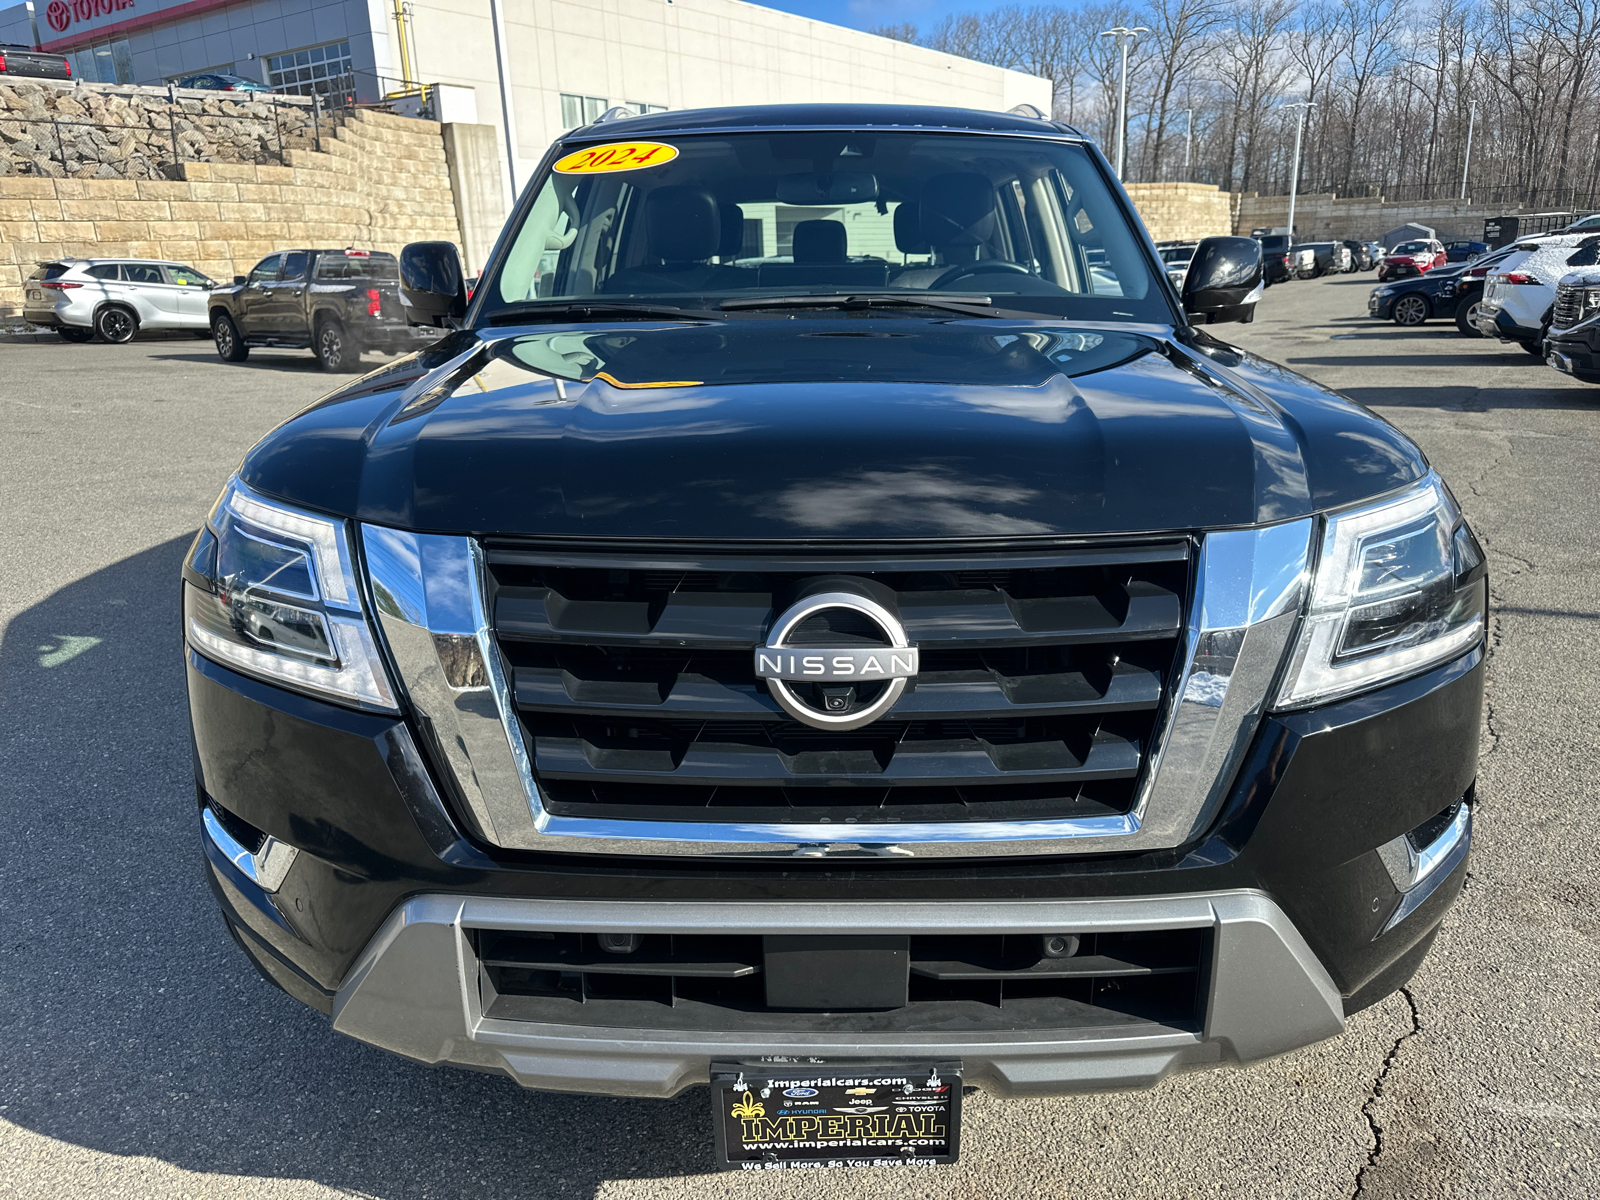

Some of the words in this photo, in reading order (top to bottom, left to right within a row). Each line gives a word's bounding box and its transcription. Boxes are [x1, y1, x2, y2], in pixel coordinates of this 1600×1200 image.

[567, 146, 662, 171] 2024
[759, 653, 913, 675] NISSAN
[848, 1098, 873, 1106] Jeep
[908, 1105, 946, 1113] TOYOTA
[741, 1113, 946, 1142] IMPERIAL
[742, 1138, 946, 1151] www.imperialcars.com
[741, 1161, 762, 1171] We
[764, 1161, 787, 1170] Sell
[827, 1160, 844, 1168] So
[846, 1159, 870, 1168] You
[872, 1159, 903, 1167] Save
[905, 1158, 937, 1166] More
